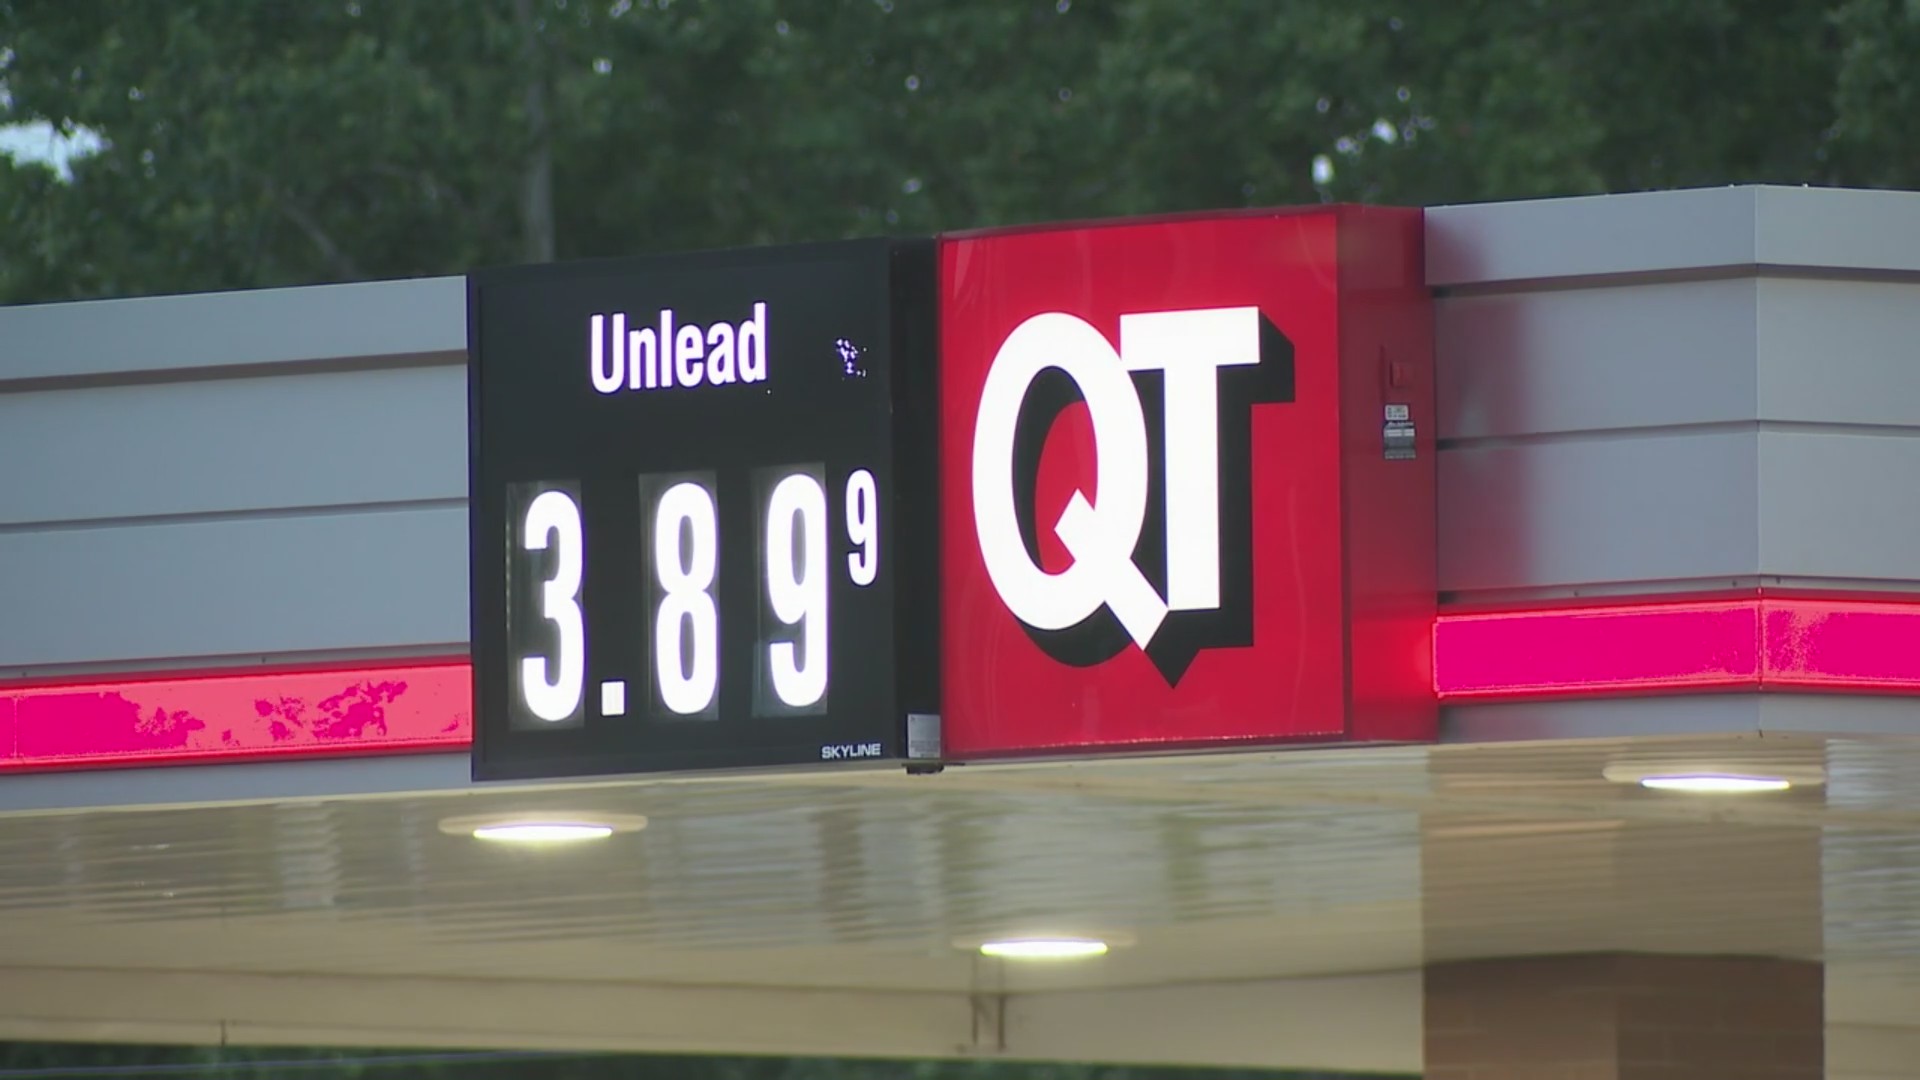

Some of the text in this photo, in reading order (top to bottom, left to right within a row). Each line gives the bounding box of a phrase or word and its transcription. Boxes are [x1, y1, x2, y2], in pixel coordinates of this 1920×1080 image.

[591, 301, 768, 394] Unlead
[972, 306, 1260, 651] QT
[821, 743, 881, 759] SKYLINE
